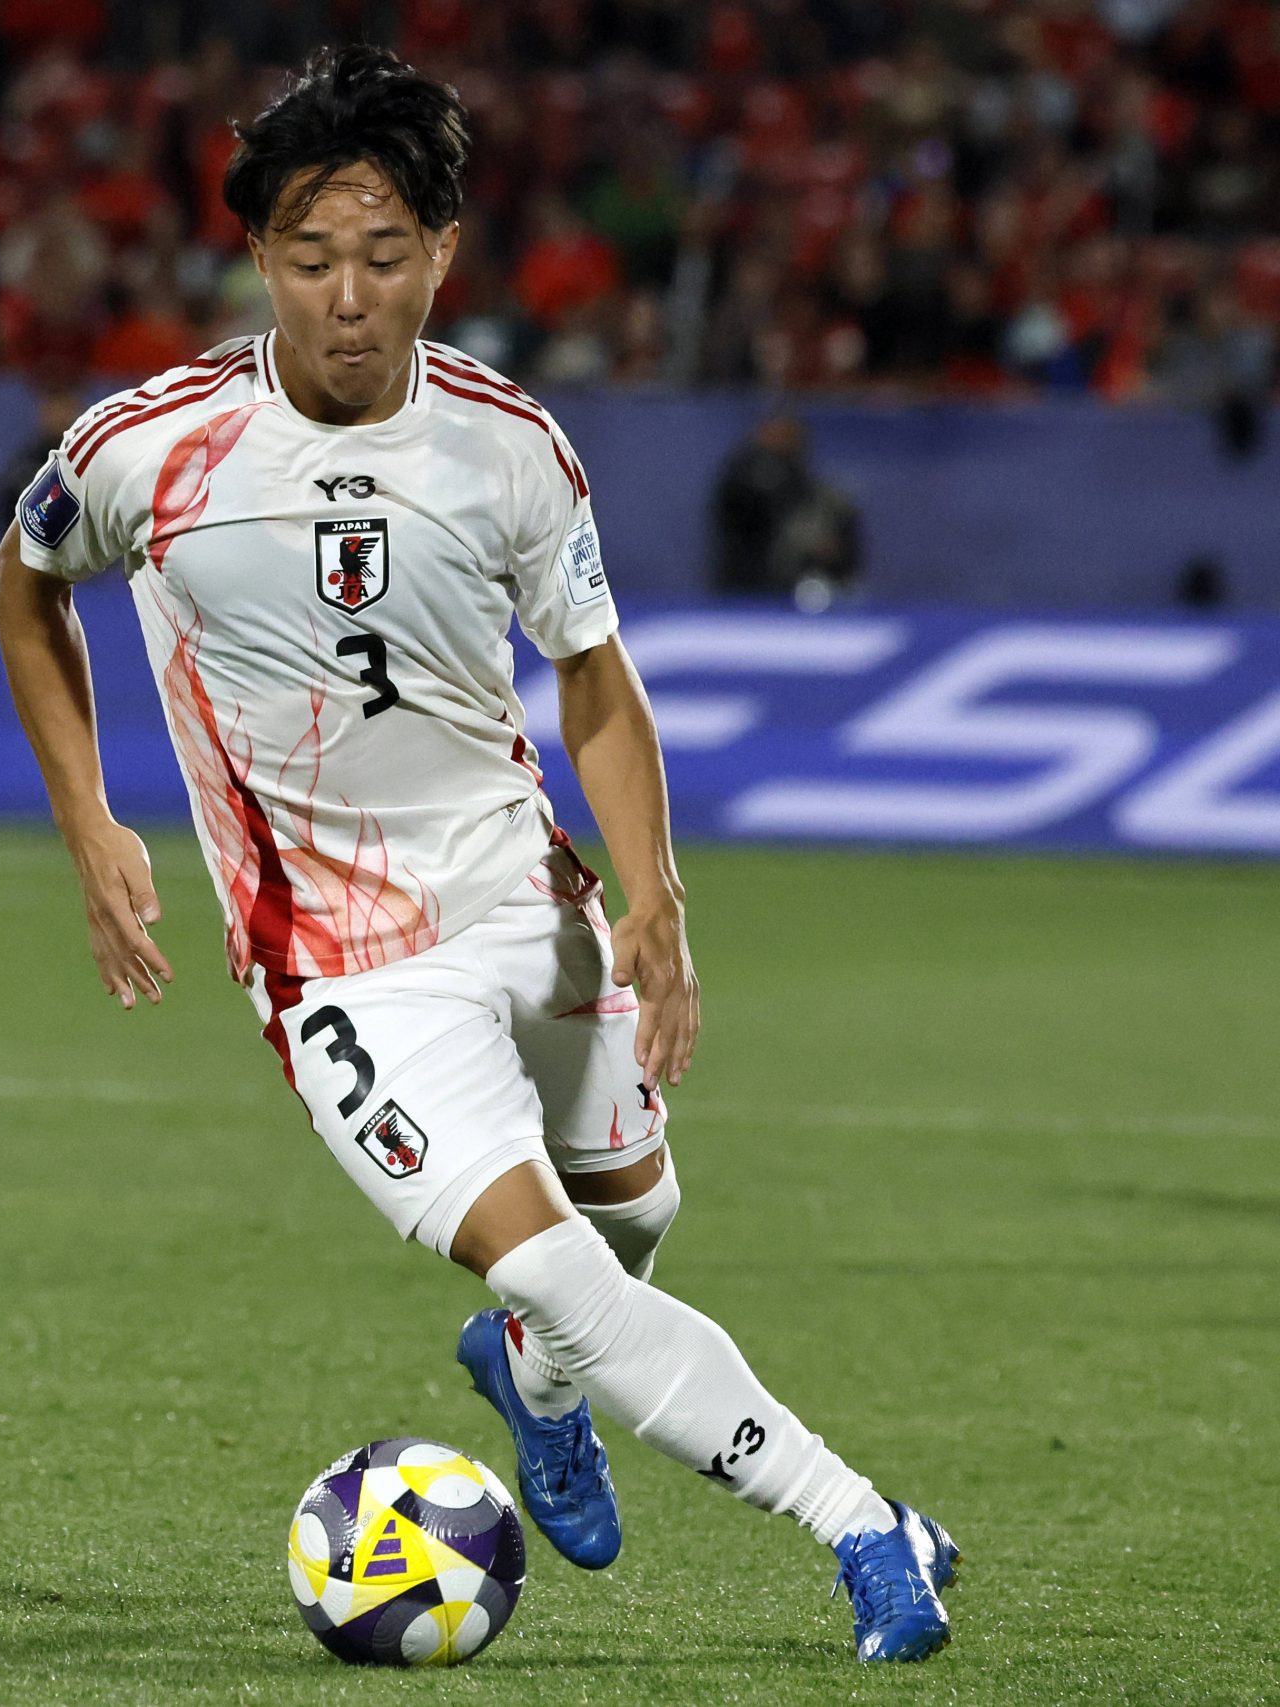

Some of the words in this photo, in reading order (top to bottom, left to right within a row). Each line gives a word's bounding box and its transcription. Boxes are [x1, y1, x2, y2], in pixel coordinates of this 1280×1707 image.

[313, 475, 376, 501] Y-3
[332, 521, 371, 531] JAPAN
[336, 585, 369, 600] JFA
[336, 633, 400, 720] 3
[301, 1005, 375, 1120] 3
[363, 1108, 386, 1135] JAPAN
[695, 1418, 766, 1482] Y-3
